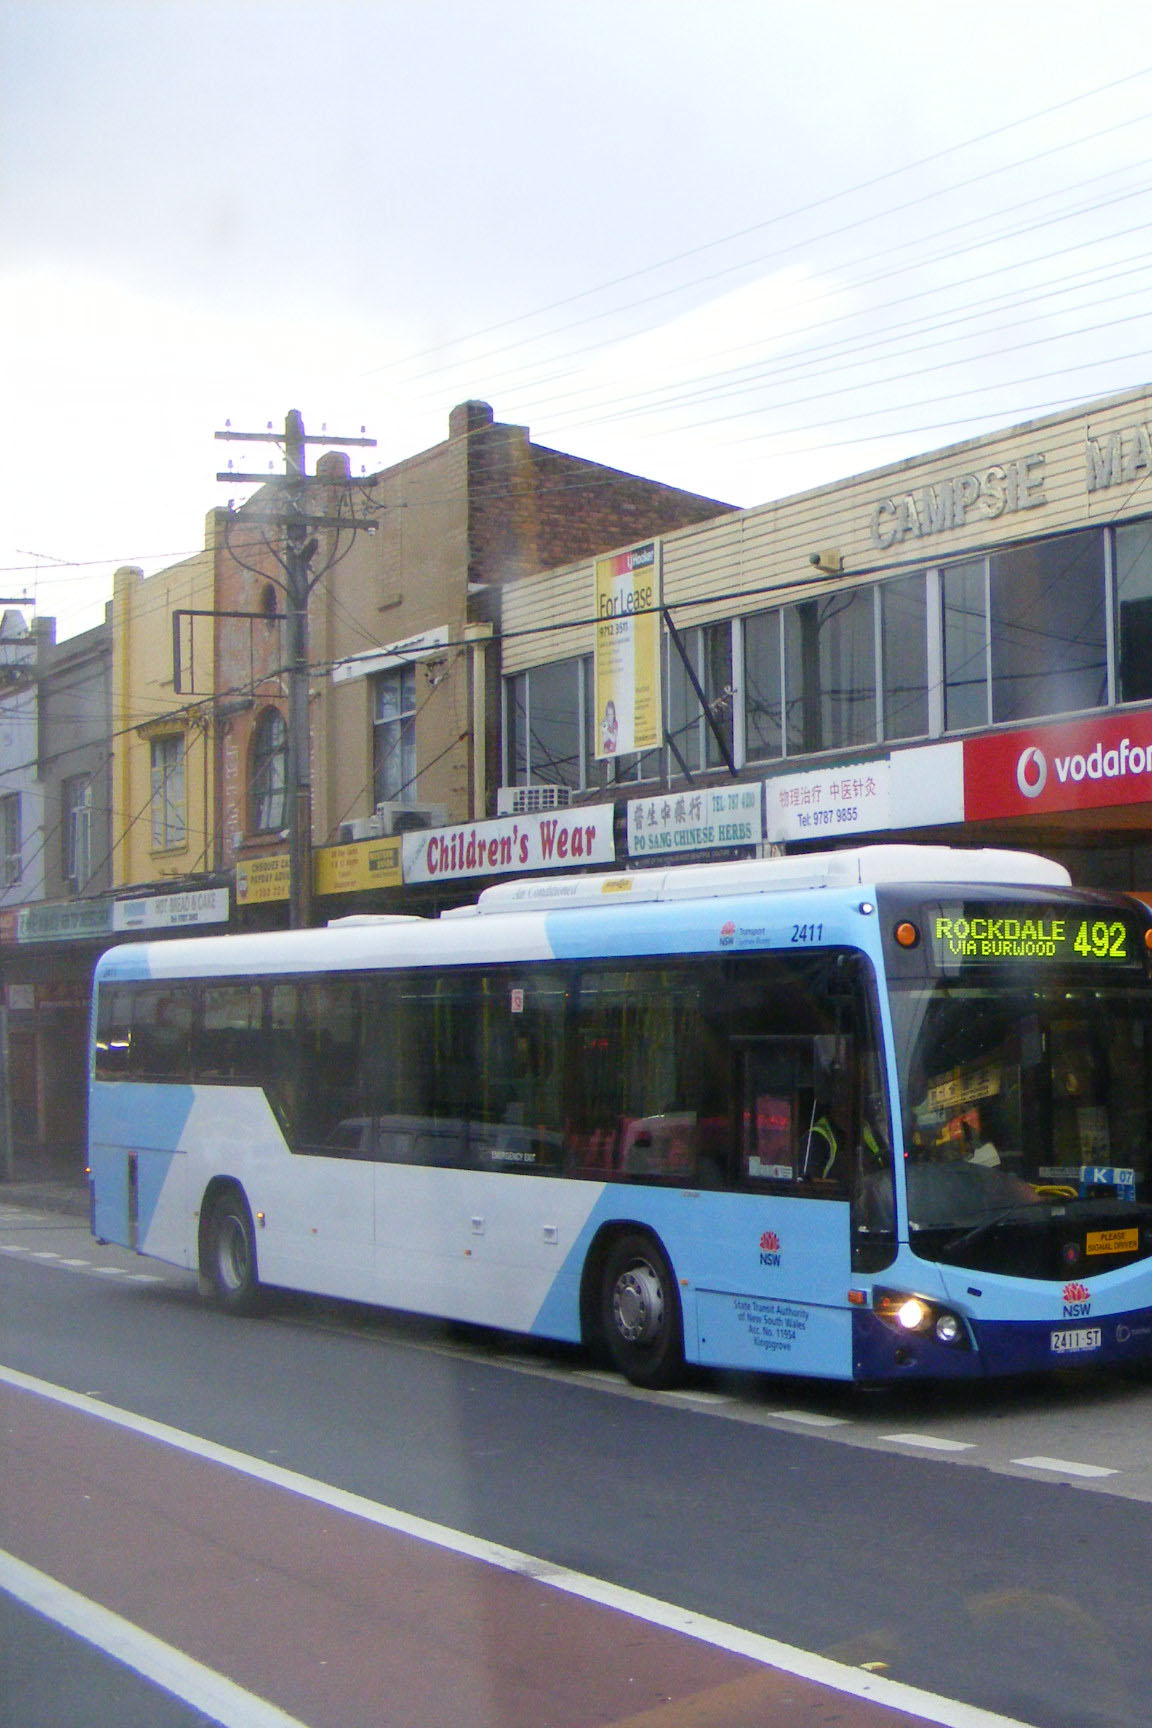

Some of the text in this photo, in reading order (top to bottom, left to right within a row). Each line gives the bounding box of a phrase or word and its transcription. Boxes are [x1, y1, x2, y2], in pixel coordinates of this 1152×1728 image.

[870, 453, 1048, 549] CAMPSIE
[600, 586, 652, 617] For Lease
[813, 810, 833, 826] 9787
[836, 807, 858, 823] 9855
[634, 822, 752, 851] PO SANG CHINESE HERBS
[427, 824, 529, 874] Children's
[540, 819, 596, 861] Wear
[791, 923, 823, 943] 2411
[936, 918, 1127, 958] ROCKDALE 492
[949, 940, 1056, 957] VIA BURWOOD
[1094, 1169, 1108, 1183] K
[1100, 1231, 1125, 1241] PLEASE
[1088, 1240, 1138, 1251] SIGNAL DRIVER
[760, 1253, 781, 1267] NSW
[734, 1299, 809, 1320] State Transit Authority
[1063, 1304, 1091, 1317] NSW
[738, 1312, 807, 1330] of New South Wales
[754, 1337, 791, 1351] Kingsgrove
